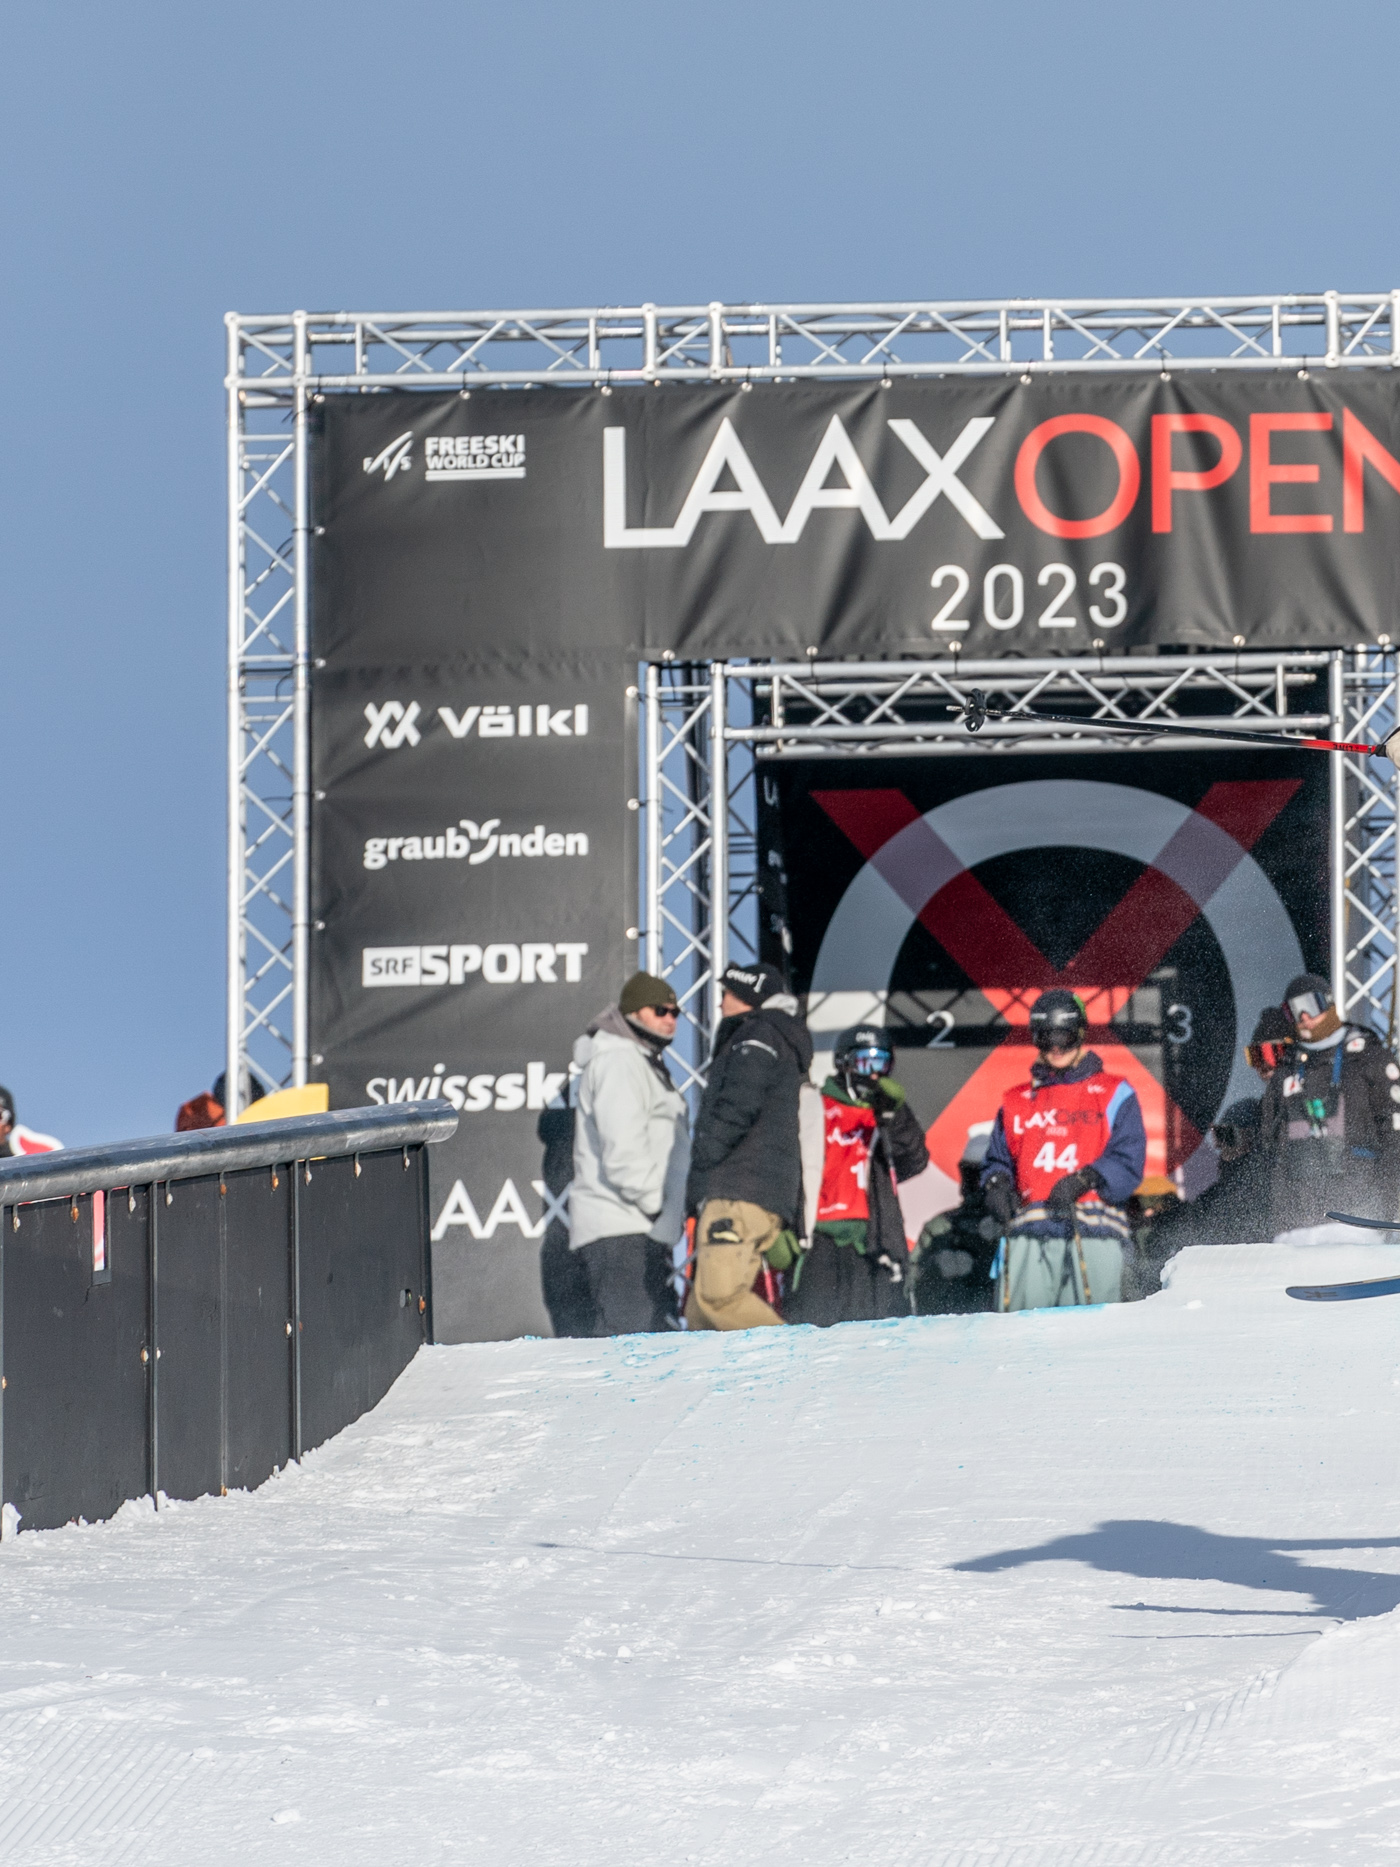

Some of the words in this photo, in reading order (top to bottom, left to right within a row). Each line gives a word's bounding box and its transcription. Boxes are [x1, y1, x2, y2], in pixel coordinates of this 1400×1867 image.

[425, 434, 525, 455] FREESKI
[426, 455, 490, 470] WORLD
[490, 453, 526, 468] CUP
[603, 413, 1006, 549] LAAX
[930, 561, 1127, 634] 2023
[371, 957, 414, 977] SRF
[420, 942, 589, 986] SPORT
[926, 1010, 956, 1048] 2
[1166, 1004, 1192, 1044] 3
[1032, 1141, 1079, 1173] 44
[431, 1178, 574, 1241] AAX
